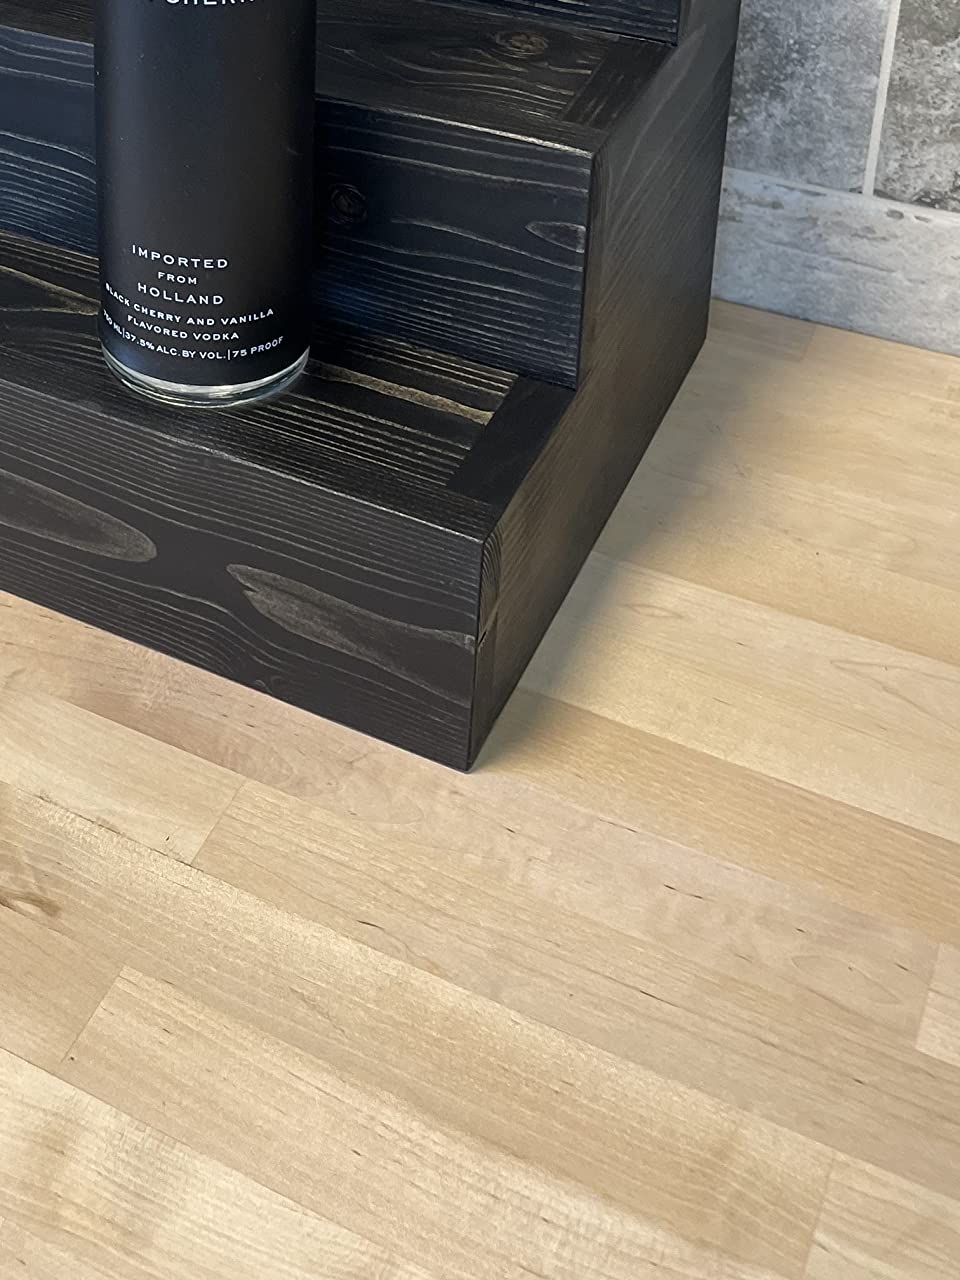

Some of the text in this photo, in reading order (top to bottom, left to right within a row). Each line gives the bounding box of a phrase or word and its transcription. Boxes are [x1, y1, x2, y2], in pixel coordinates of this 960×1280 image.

[132, 245, 228, 269] IMPORTED
[158, 272, 197, 285] FROM
[105, 282, 274, 326] BLACK CHERRY AND VANILLA
[138, 283, 224, 305] HOLLAND
[127, 314, 240, 341] FLAVORED VODKA
[250, 336, 284, 355] PROOF
